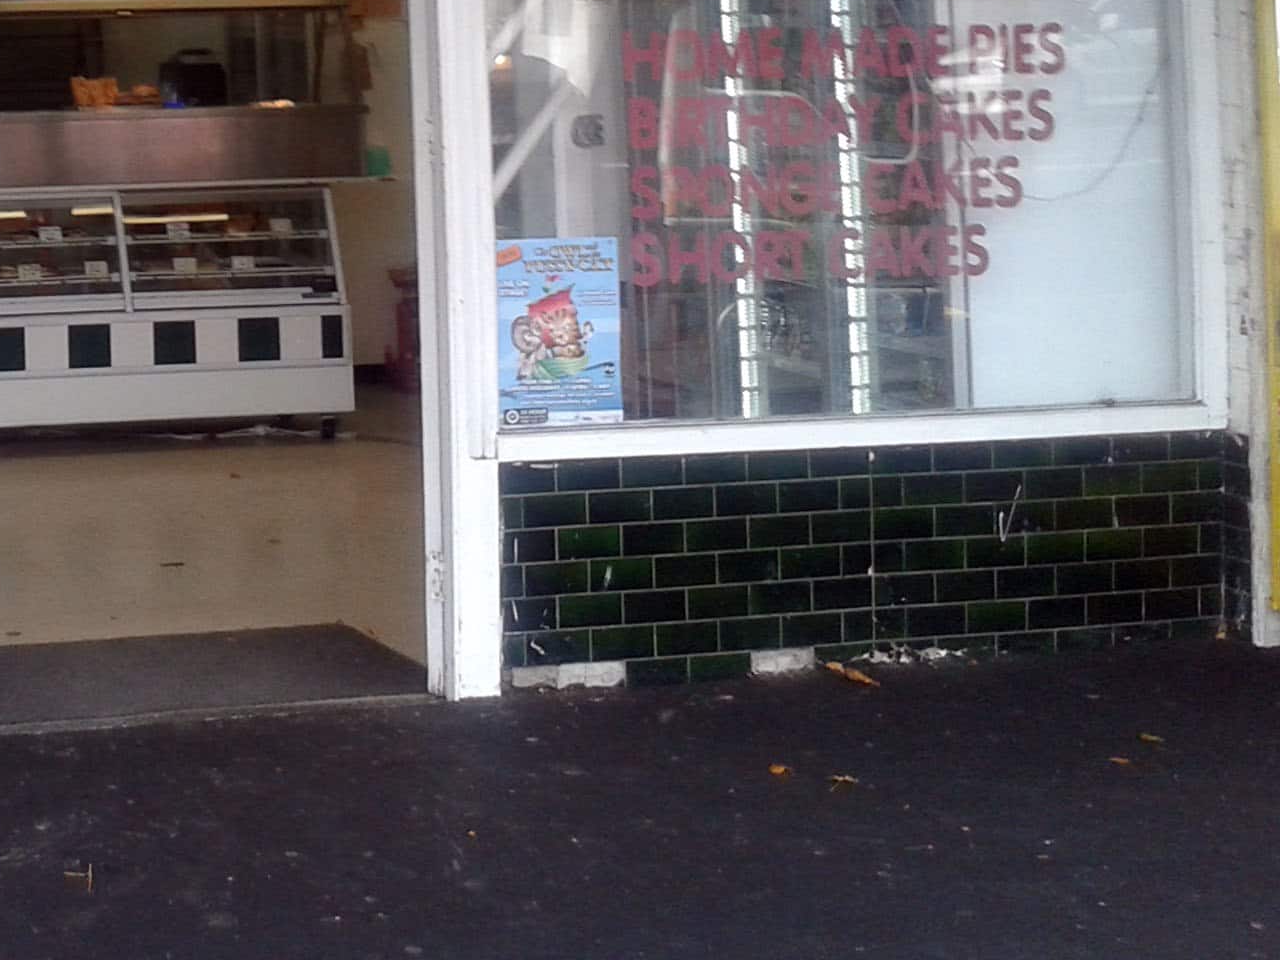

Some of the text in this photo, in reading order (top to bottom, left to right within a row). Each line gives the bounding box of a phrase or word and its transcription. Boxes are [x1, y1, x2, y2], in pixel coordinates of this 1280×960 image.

[622, 22, 1067, 82] HOME MADE PIES
[895, 88, 1057, 144] CAKES
[631, 155, 1025, 222] SPONGE CAKES
[631, 223, 991, 288] SHORT CAKES
